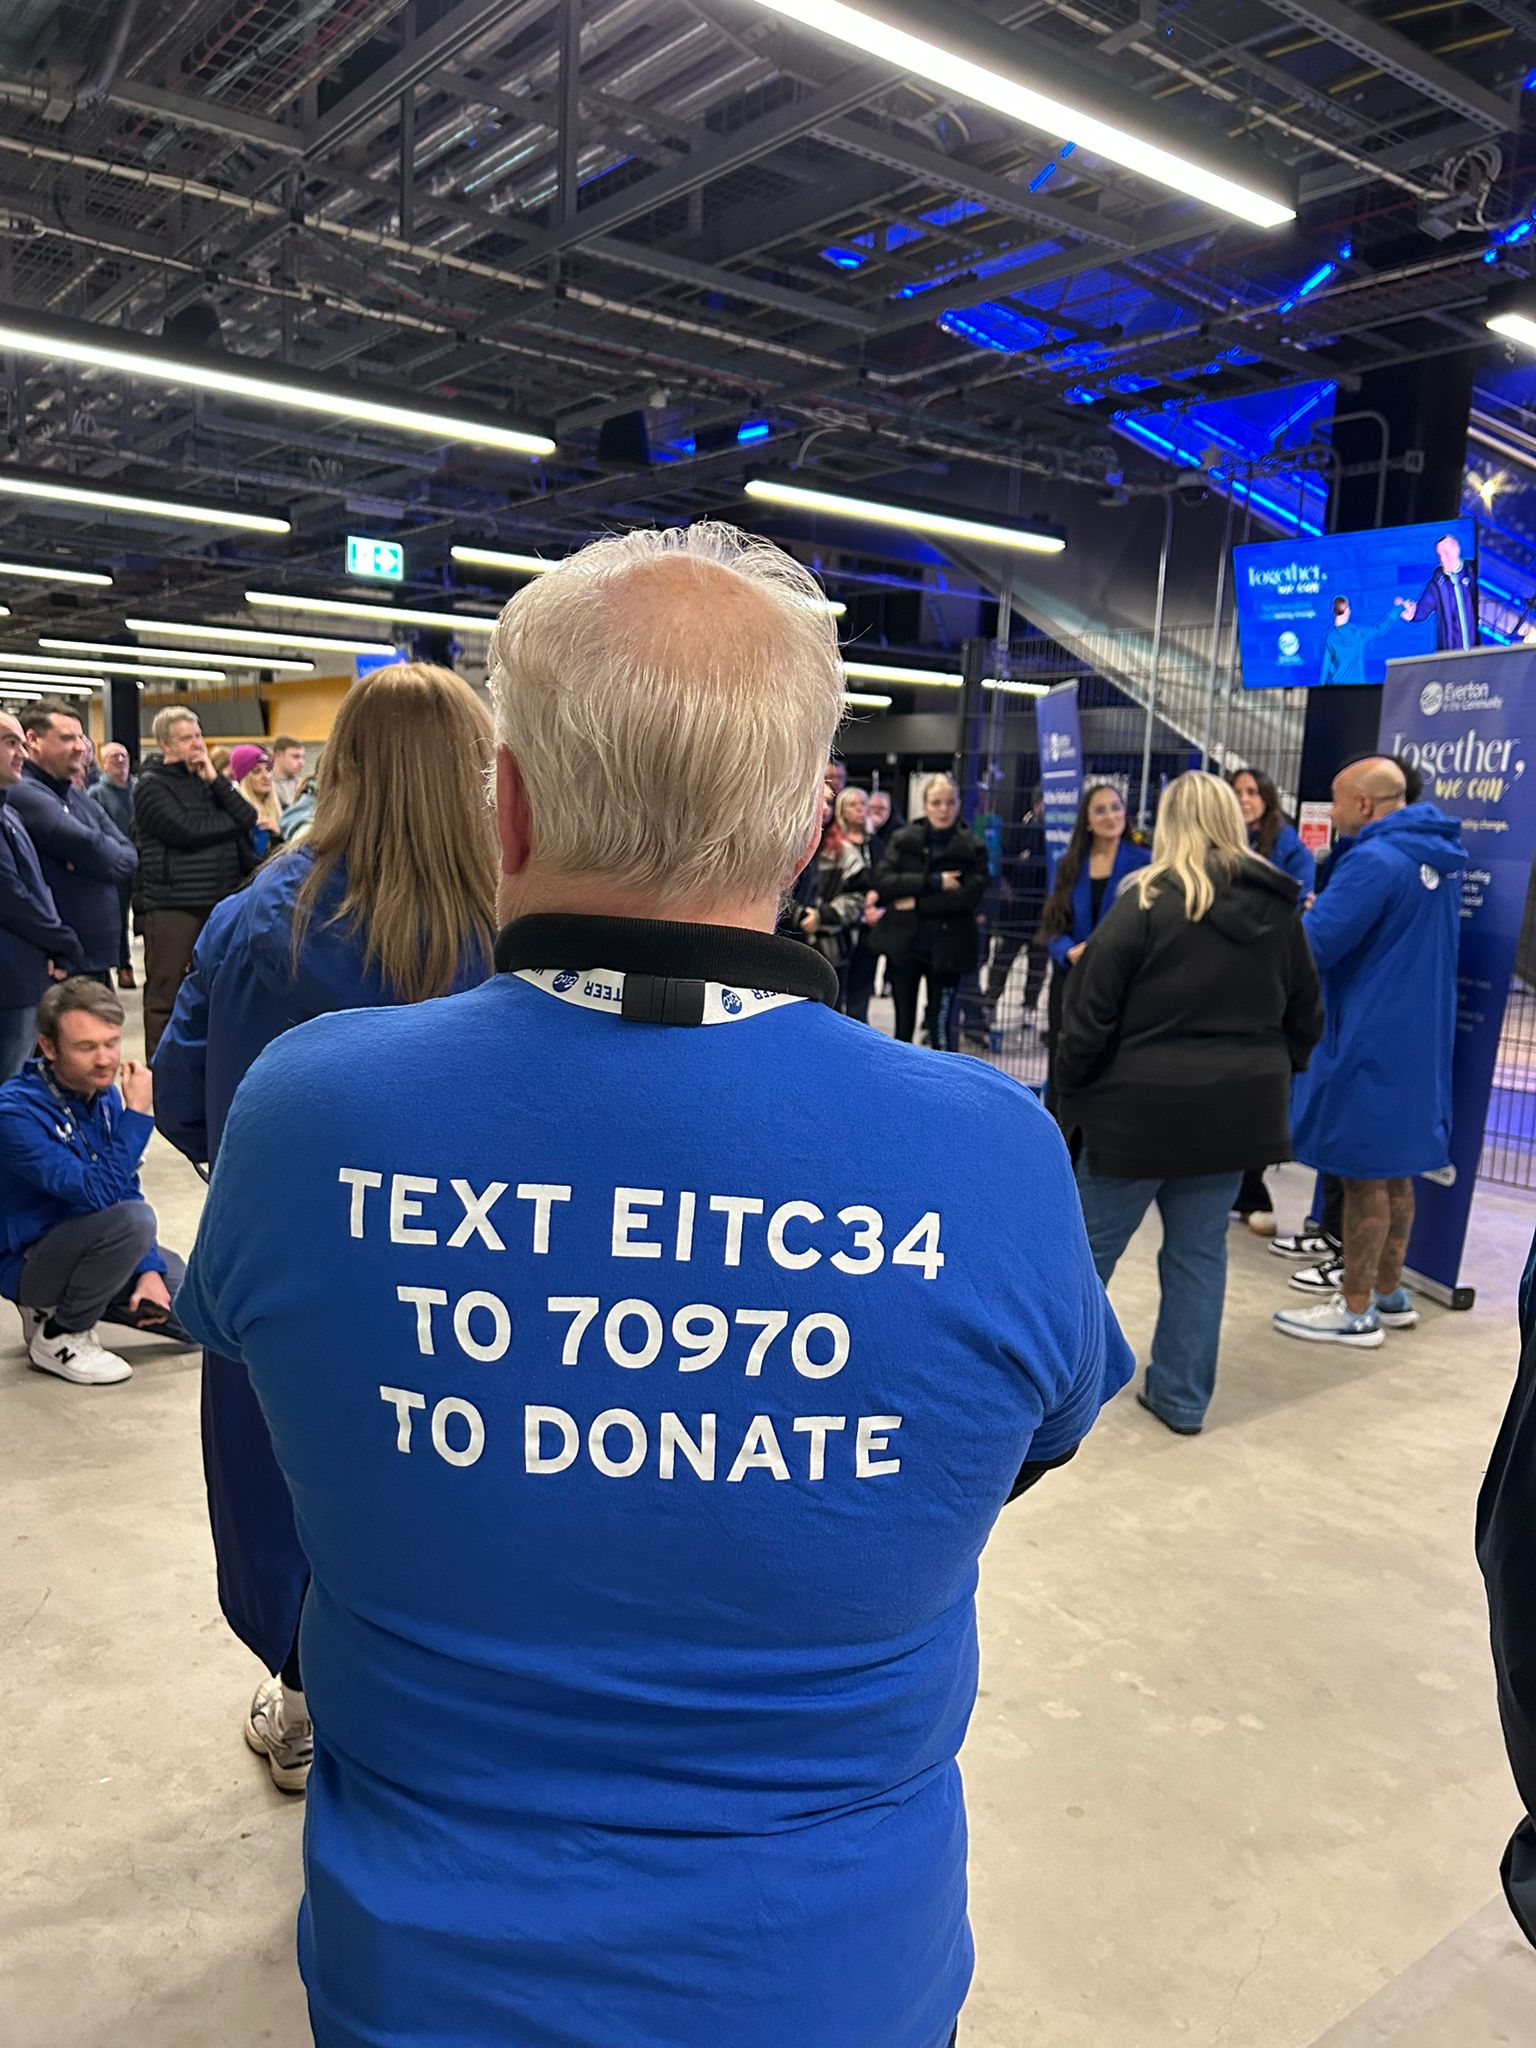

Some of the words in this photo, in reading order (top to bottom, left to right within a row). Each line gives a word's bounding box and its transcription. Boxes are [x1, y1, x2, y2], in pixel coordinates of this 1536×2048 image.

[1391, 728, 1526, 785] Together,
[1435, 777, 1464, 800] we
[1467, 776, 1511, 803] can
[339, 1168, 571, 1253] TEXT
[612, 1188, 944, 1279] EITC34
[397, 1286, 511, 1361] TO
[548, 1297, 850, 1379] 70970
[380, 1386, 484, 1466] TO
[525, 1405, 902, 1481] DONATE
